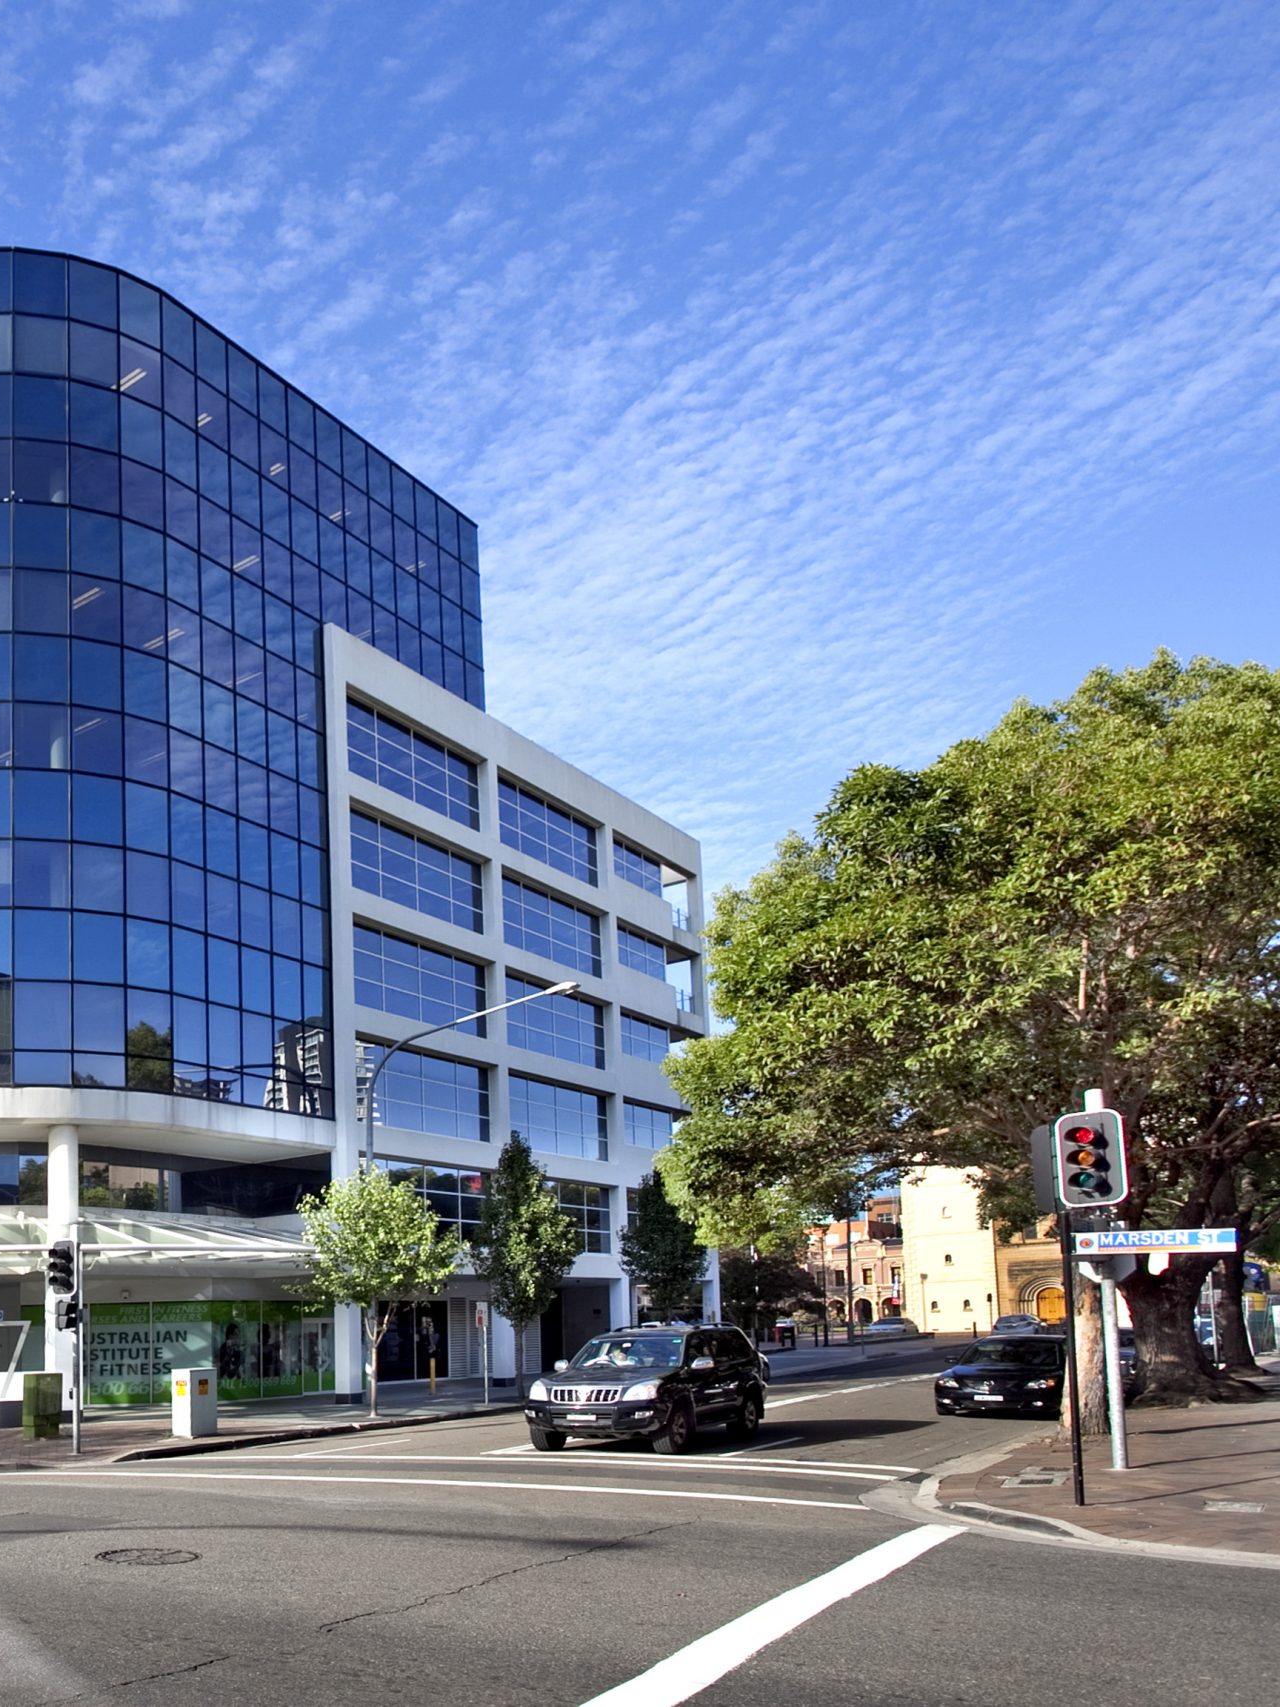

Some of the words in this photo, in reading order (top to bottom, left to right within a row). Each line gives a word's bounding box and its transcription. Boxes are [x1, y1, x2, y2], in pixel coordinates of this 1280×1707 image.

[1100, 1231, 1189, 1246] MARSDEN
[1197, 1230, 1218, 1244] ST
[119, 1306, 147, 1315] FIRST
[167, 1303, 208, 1313] FITNESS
[92, 1315, 118, 1324] RSES
[120, 1315, 147, 1324] AND
[153, 1313, 202, 1322] CAREERS
[83, 1330, 187, 1345] USTRALIAN
[83, 1347, 163, 1361] STITUTE
[100, 1362, 172, 1376] FITNESS
[90, 1381, 125, 1395] 300
